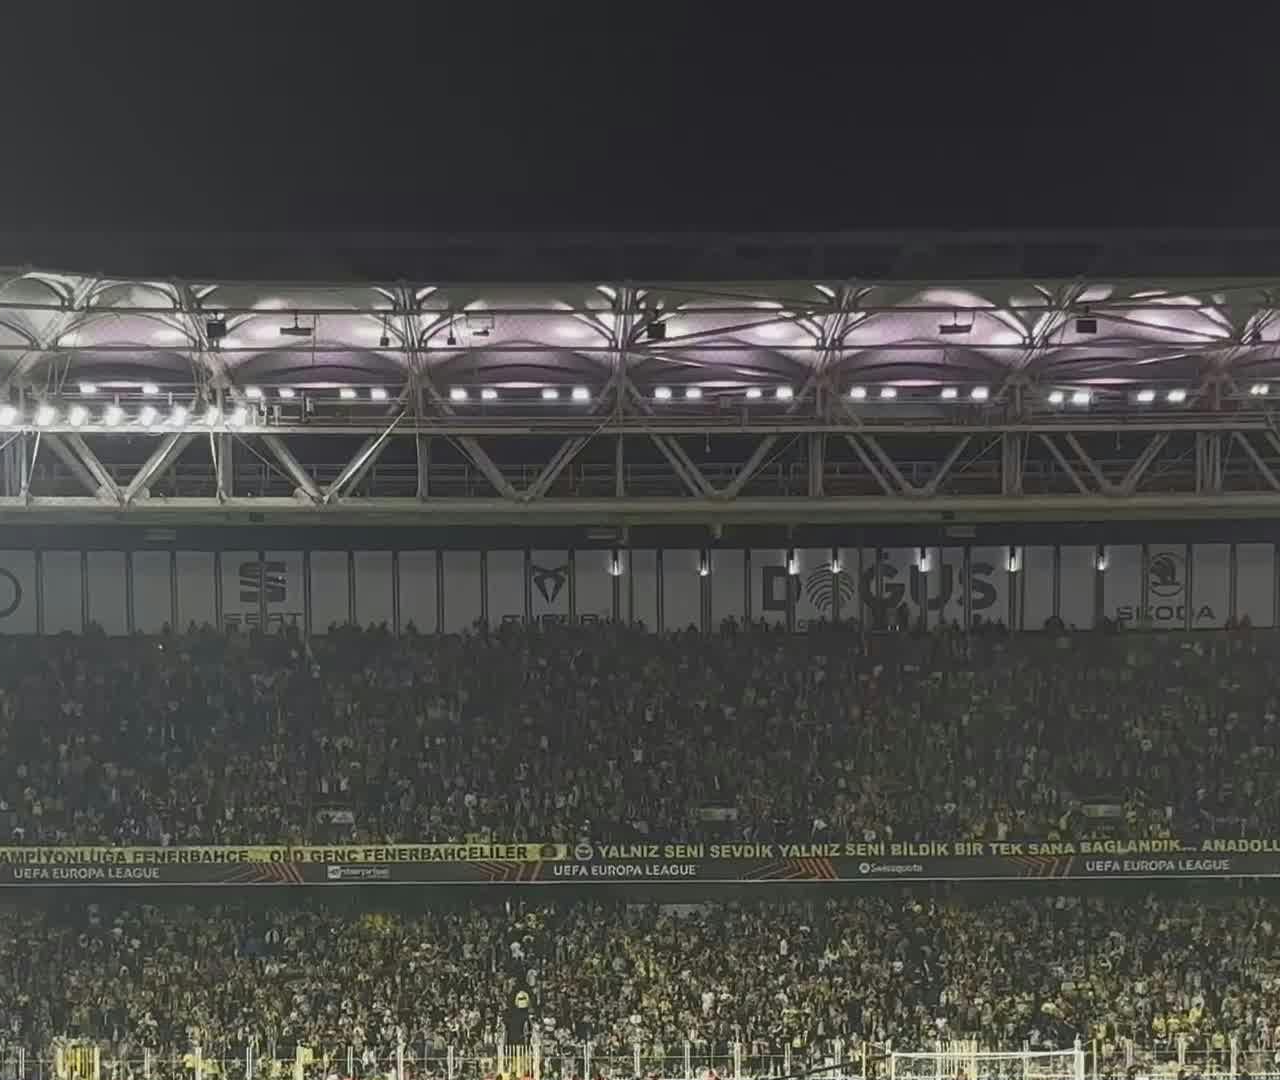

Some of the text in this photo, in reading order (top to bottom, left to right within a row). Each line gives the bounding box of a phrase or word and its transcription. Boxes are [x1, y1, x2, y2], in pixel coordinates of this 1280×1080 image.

[599, 844, 660, 858] YALNIZ
[780, 843, 841, 858] YALNIZ
[988, 843, 1024, 856] TEK
[1027, 842, 1076, 856] SANA
[553, 865, 696, 877] UEFA EUROPA LEAGUE
[1085, 860, 1230, 872] UEFA EUROPA LEAGUE
[13, 867, 161, 880] UEFA EUROPA LEAGUE
